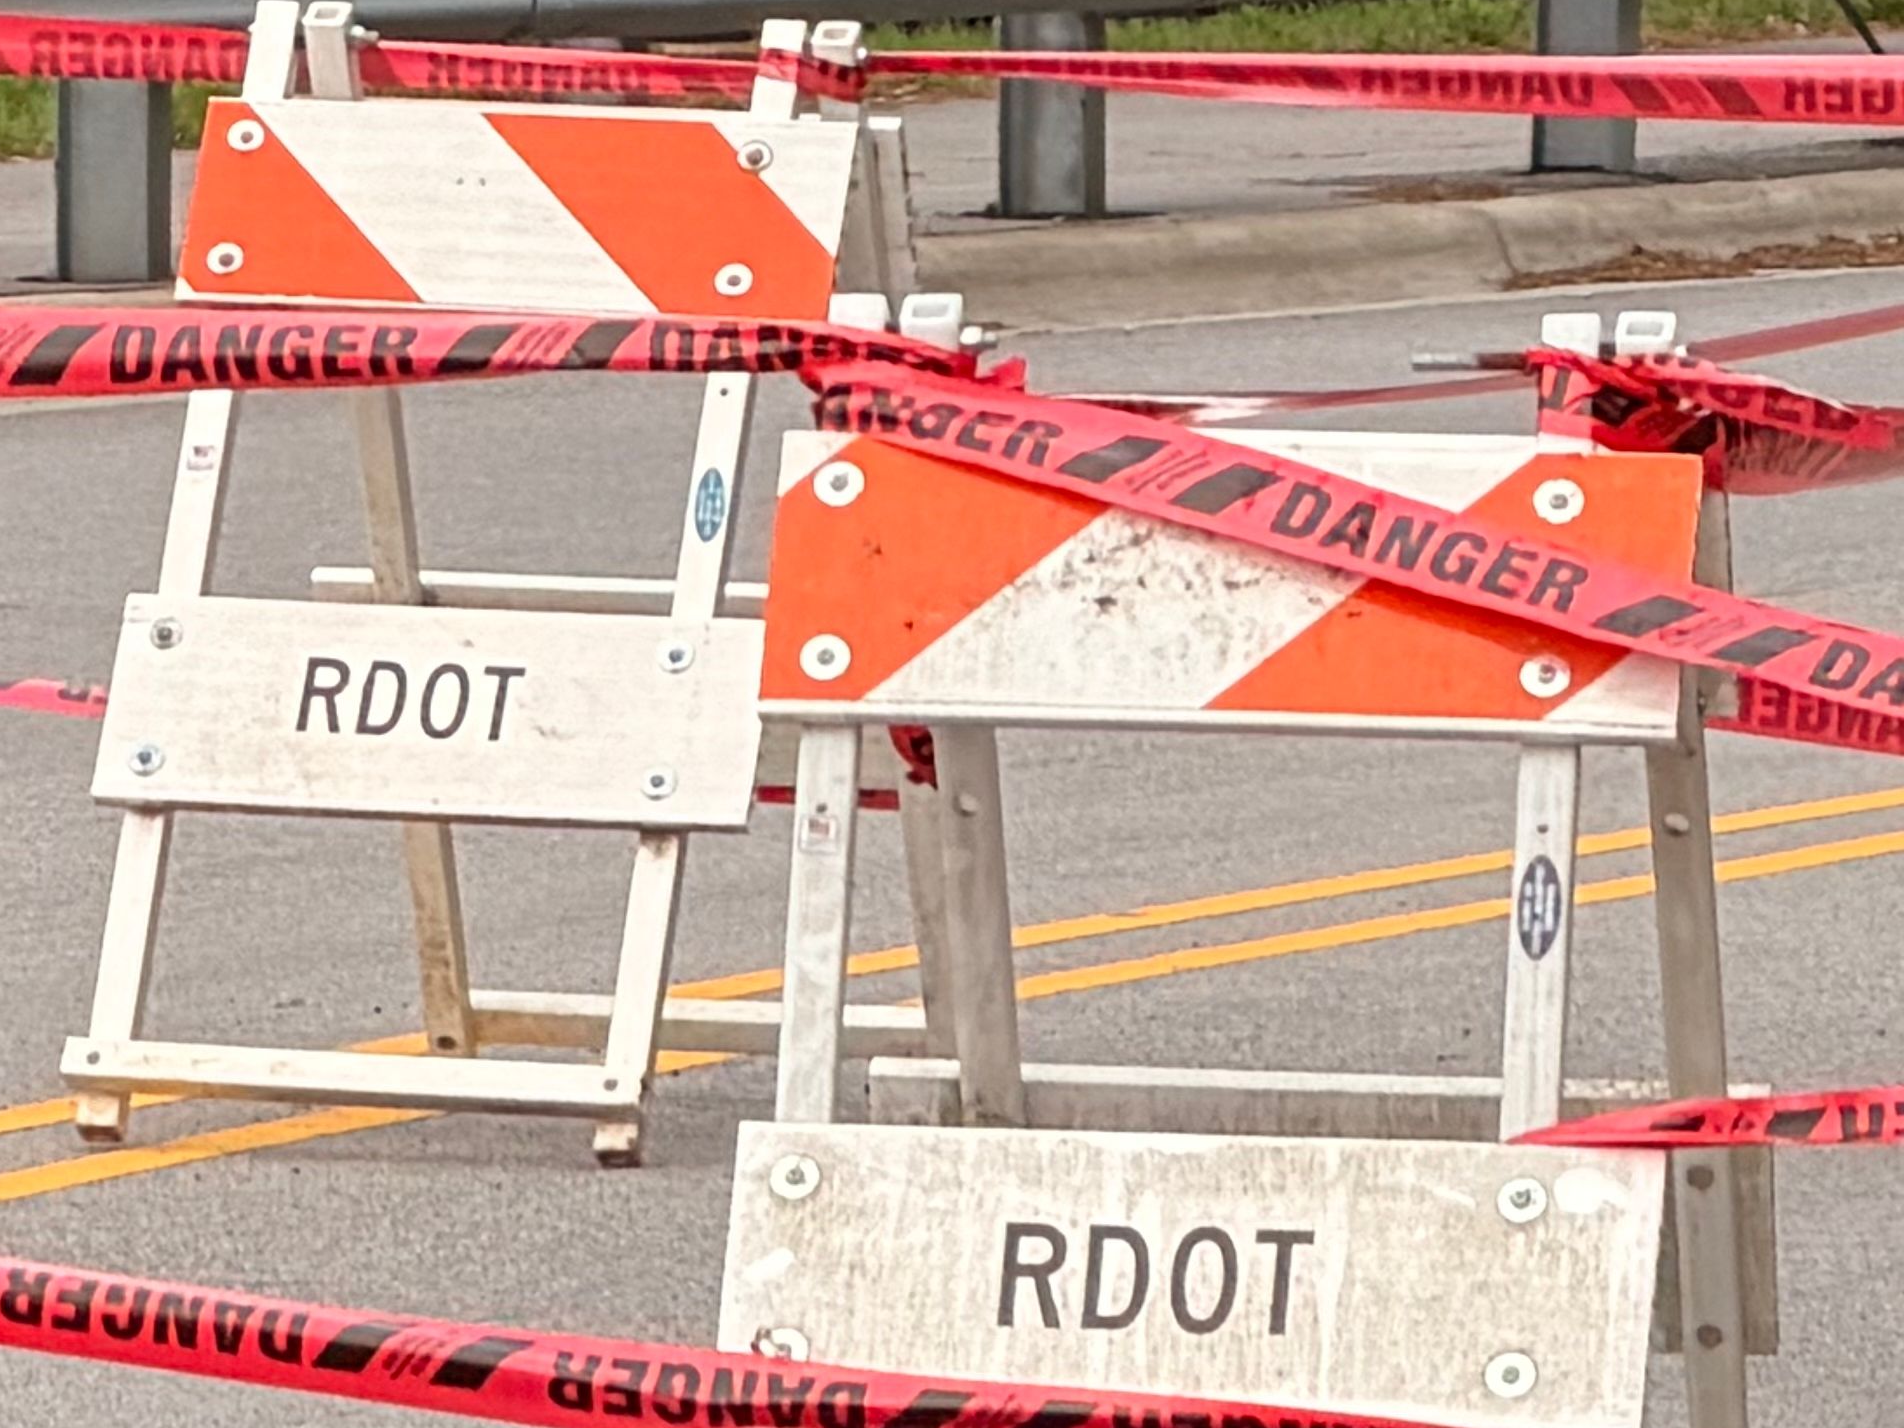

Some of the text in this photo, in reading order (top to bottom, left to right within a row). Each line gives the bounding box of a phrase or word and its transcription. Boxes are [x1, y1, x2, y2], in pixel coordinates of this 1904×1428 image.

[109, 321, 421, 384] DANGER
[1271, 480, 1589, 614] DANGER
[295, 657, 526, 742] RDOT
[0, 1268, 309, 1366] DANGER
[996, 1221, 1315, 1336] RDOT
